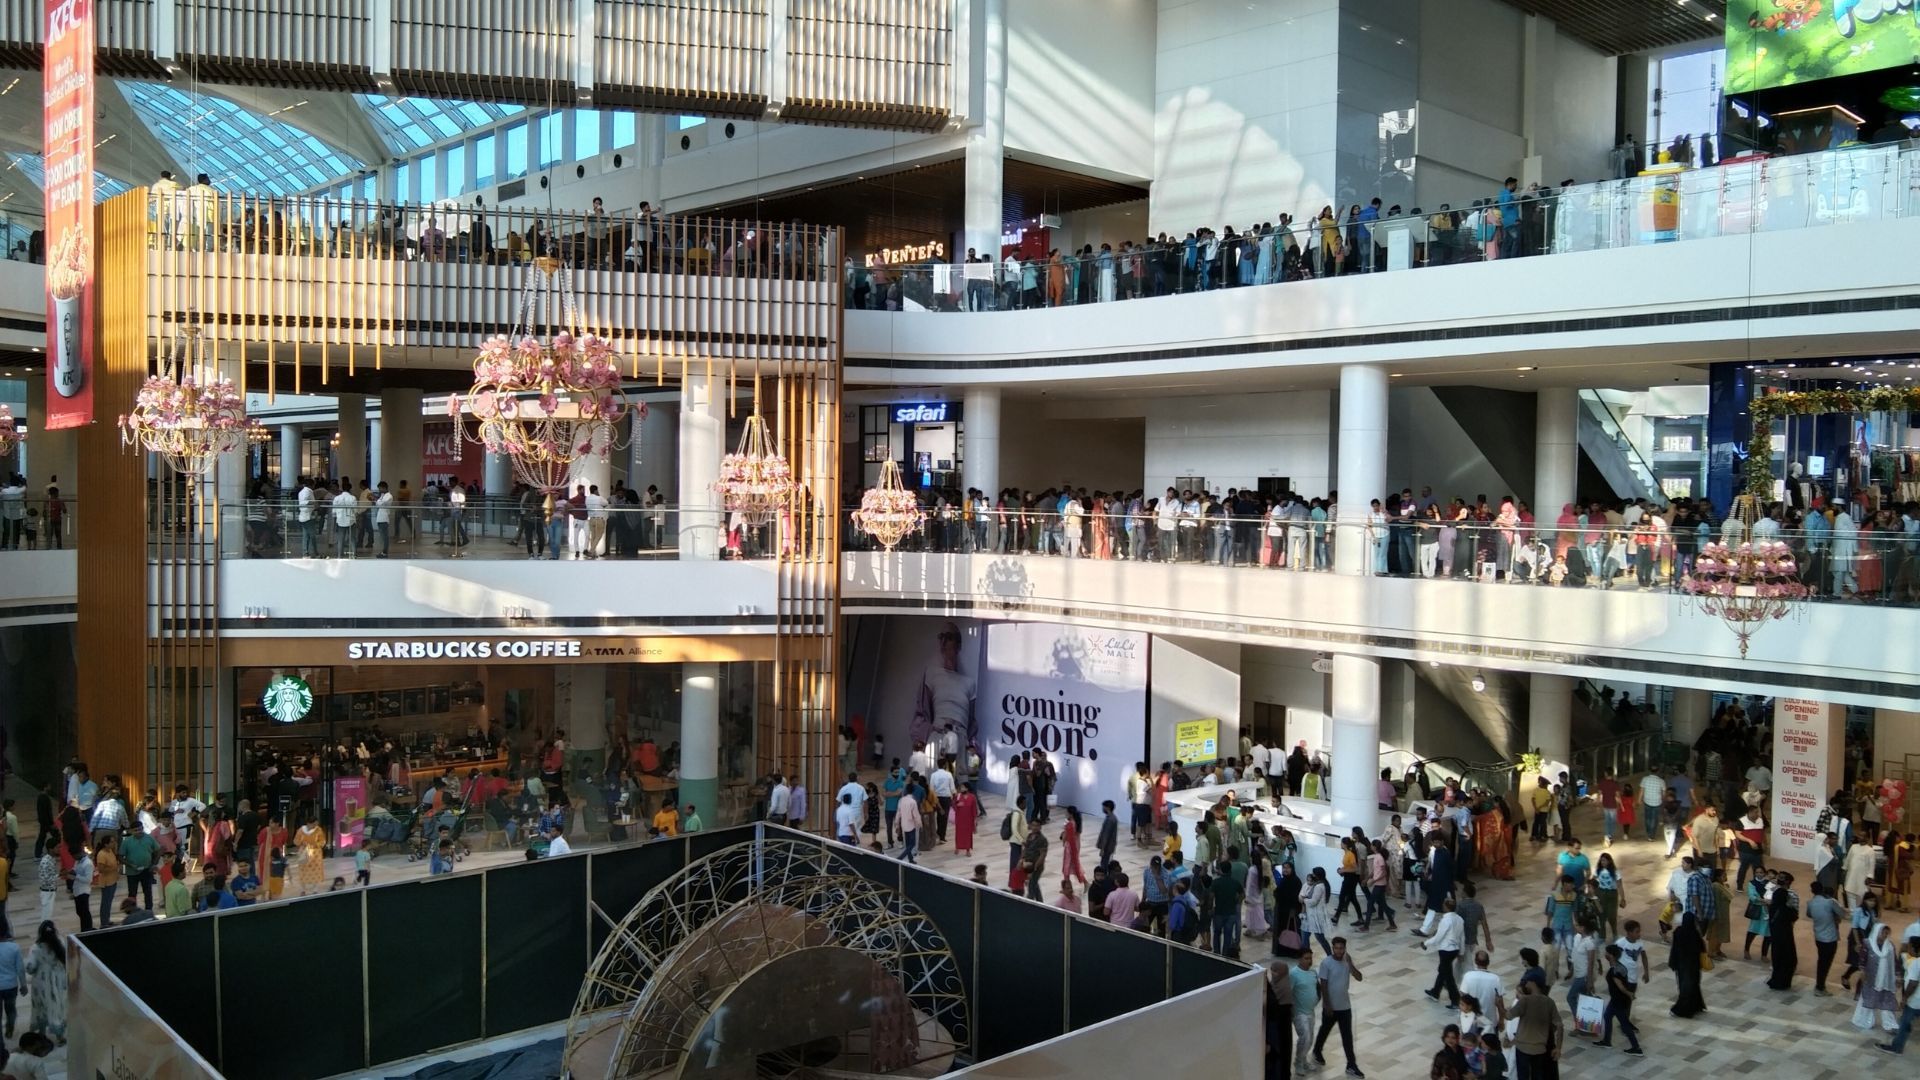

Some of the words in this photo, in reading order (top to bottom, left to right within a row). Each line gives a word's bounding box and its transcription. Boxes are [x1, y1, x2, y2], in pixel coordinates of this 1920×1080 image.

[48, 0, 82, 48] KFC
[896, 403, 948, 422] safari
[425, 434, 457, 455] KFC
[349, 641, 491, 659] STARBUCKS
[496, 641, 581, 657] COFFEE
[585, 648, 593, 656] A
[594, 648, 624, 656] TATA
[629, 648, 663, 656] Alliance
[1106, 650, 1136, 659] MALL
[1002, 690, 1101, 738] coming
[1784, 704, 1820, 715] OPENING!
[1001, 718, 1098, 761] soon.
[1783, 736, 1819, 747] OPENING!
[1782, 767, 1818, 778] OPENING!
[1781, 797, 1817, 808] OPENING!
[1780, 828, 1816, 840] OPENING!
